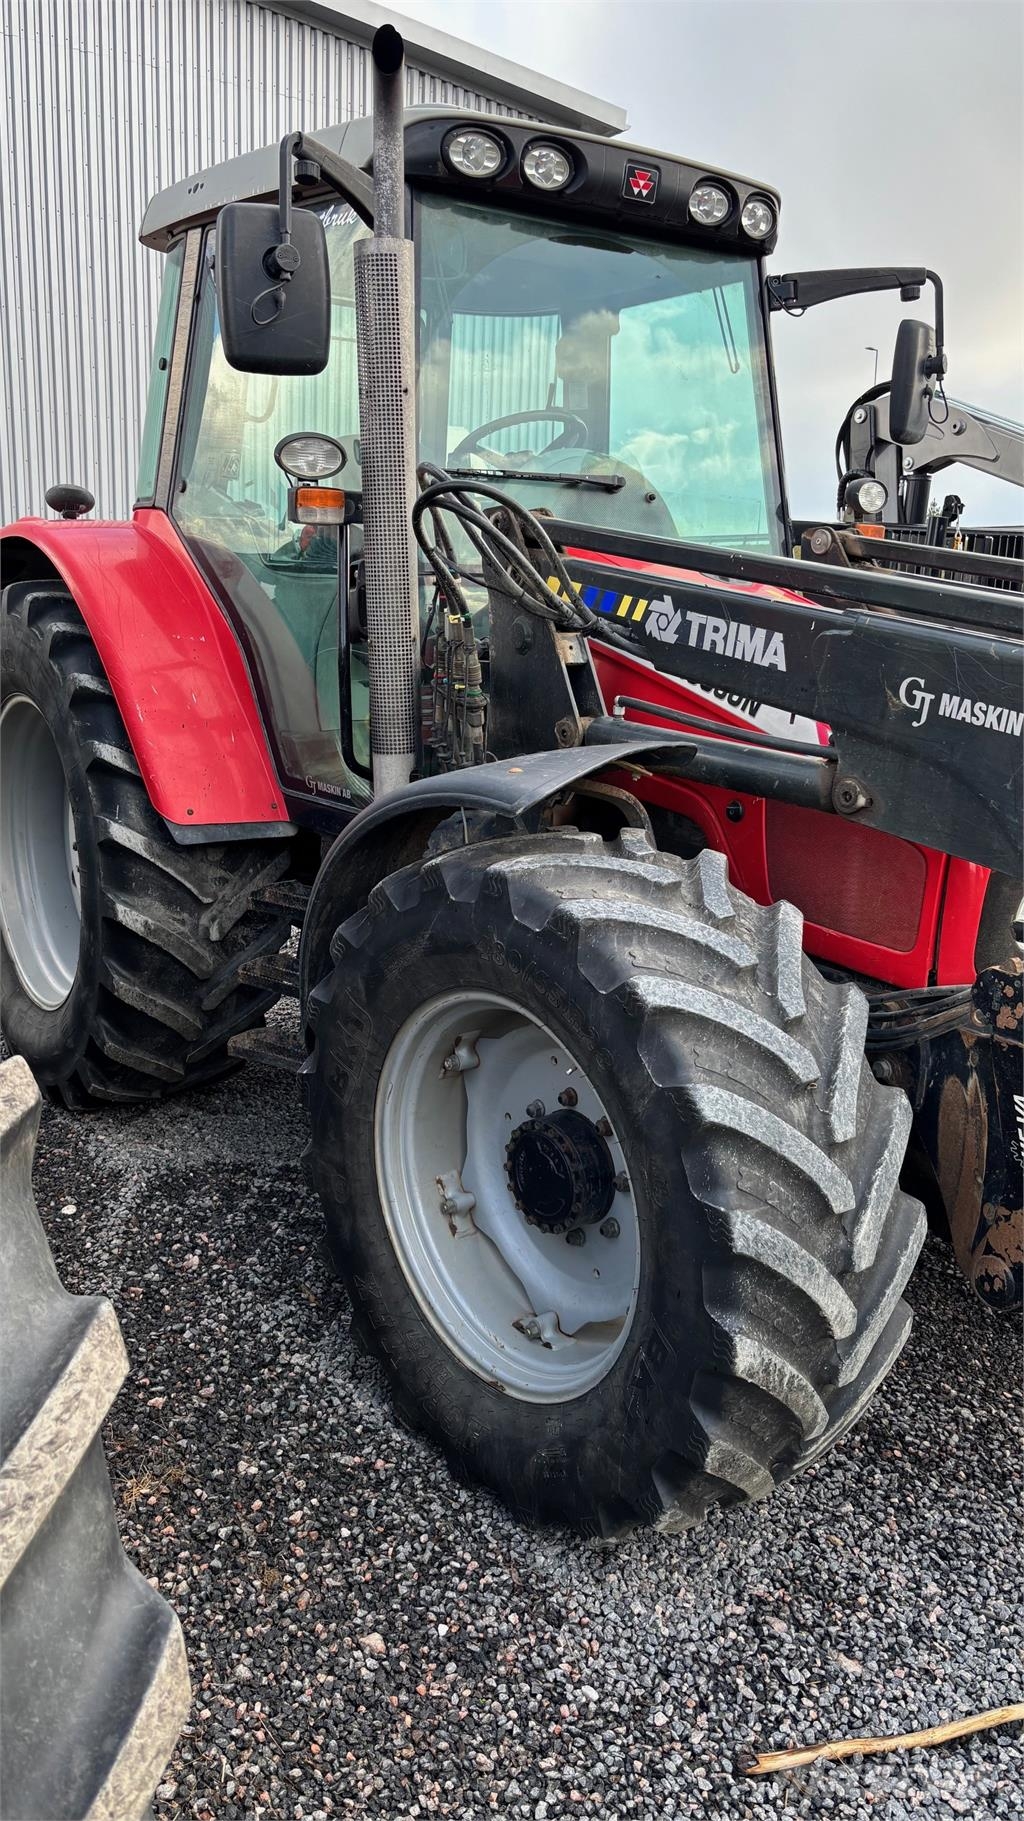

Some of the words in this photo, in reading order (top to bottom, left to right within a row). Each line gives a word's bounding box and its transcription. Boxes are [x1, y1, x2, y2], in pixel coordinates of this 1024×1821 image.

[685, 610, 787, 672] TRIMA
[898, 676, 935, 727] GJ
[938, 692, 1024, 737] MASKIN
[317, 781, 341, 797] MASKIN
[342, 788, 351, 799] AB
